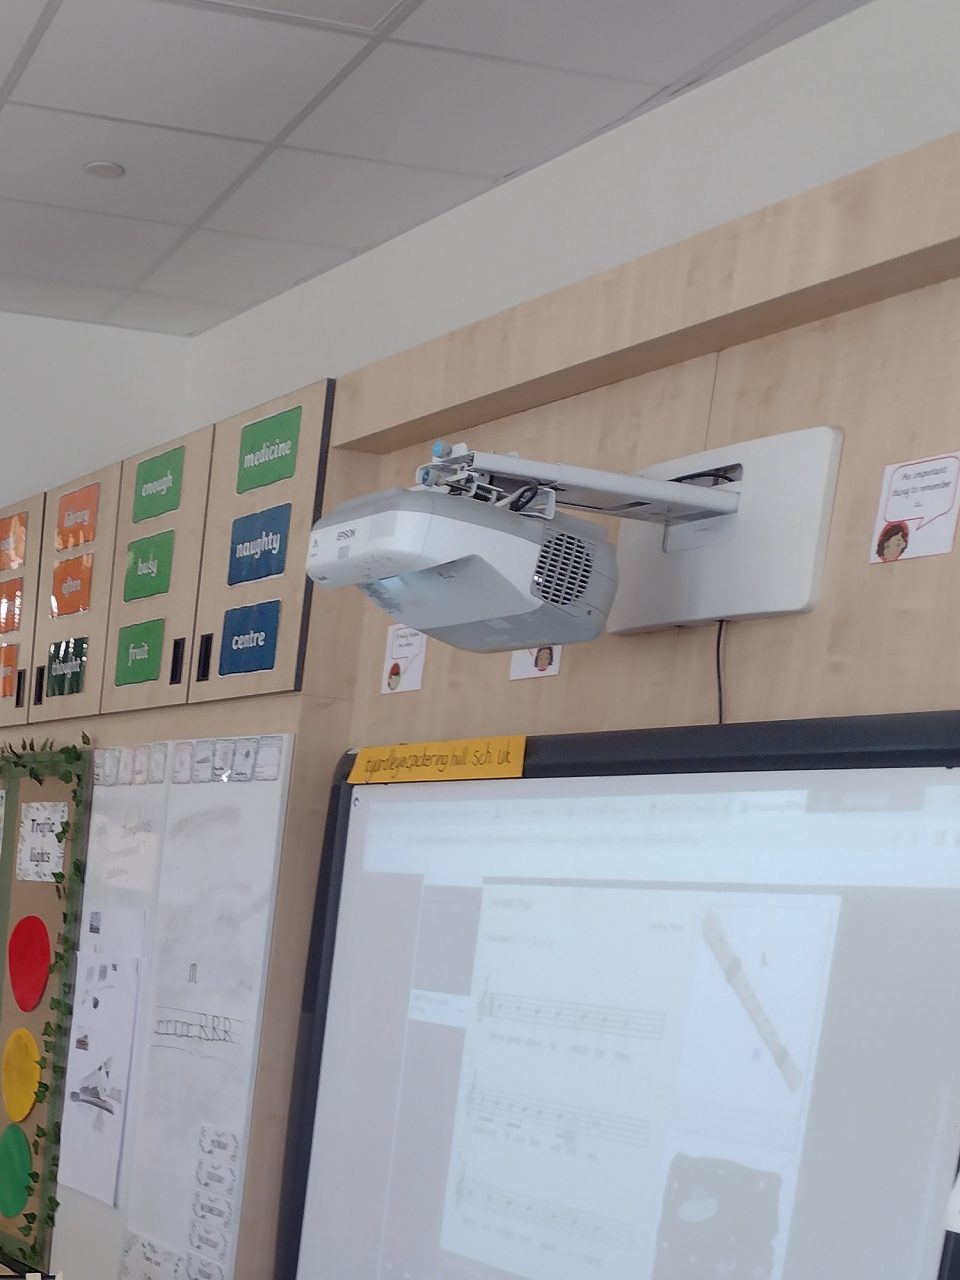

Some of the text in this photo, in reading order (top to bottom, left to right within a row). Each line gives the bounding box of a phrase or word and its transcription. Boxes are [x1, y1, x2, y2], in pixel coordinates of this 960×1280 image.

[244, 438, 291, 469] medicine
[141, 471, 173, 497] enough
[64, 508, 90, 529] library
[236, 532, 281, 559] naughty
[336, 528, 356, 541] EPSON
[137, 557, 158, 577] busy
[61, 576, 82, 599] often
[231, 629, 266, 650] centre
[127, 642, 150, 667] fruit
